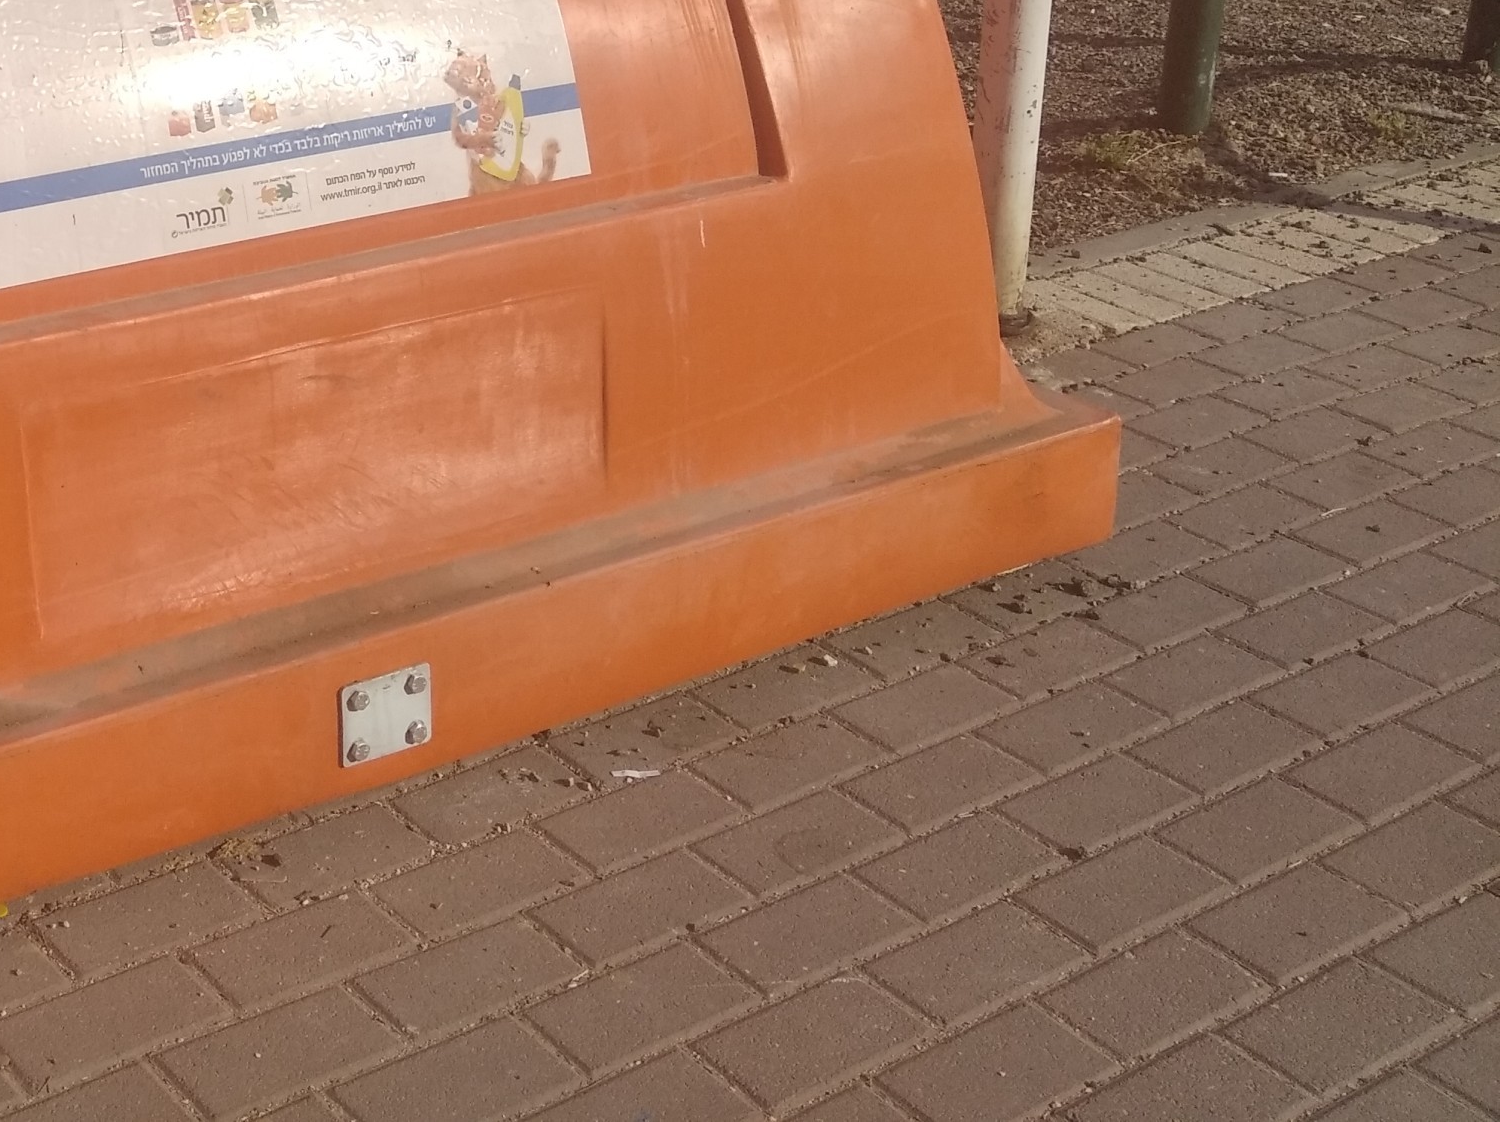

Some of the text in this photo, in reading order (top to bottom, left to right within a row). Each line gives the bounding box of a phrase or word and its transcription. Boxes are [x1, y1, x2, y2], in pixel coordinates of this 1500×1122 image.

[139, 115, 437, 179] יש להשליך אריזות ריקות בלבד בכדי לא לפגוע בתהליך המחזור
[325, 160, 416, 186] למידע נוסף על הפח הכתום
[320, 175, 426, 202] היכנסו לאתר www.tmir.org.il
[175, 206, 227, 230] תמיר
